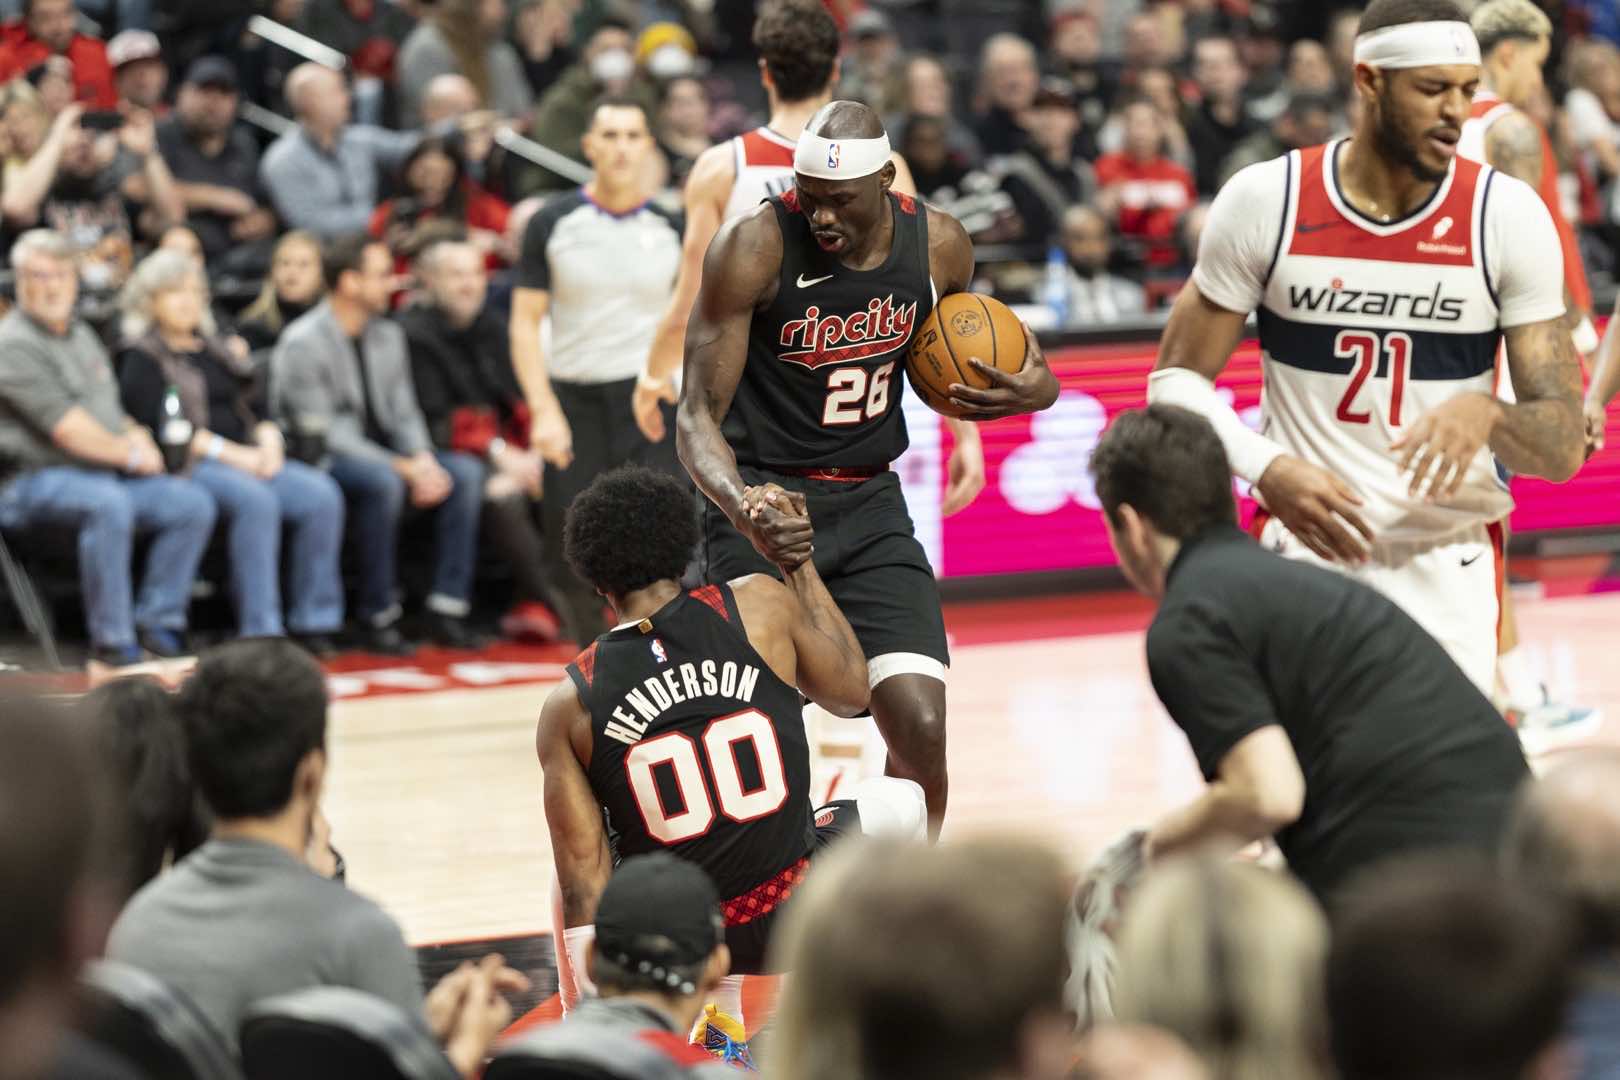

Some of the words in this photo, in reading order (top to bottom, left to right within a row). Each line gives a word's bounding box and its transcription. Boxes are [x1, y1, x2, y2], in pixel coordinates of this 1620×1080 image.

[777, 294, 917, 368] ripcity
[1289, 278, 1466, 321] wizards
[822, 362, 895, 425] 26
[1334, 330, 1413, 428] 21
[604, 660, 760, 745] HENDERSON
[624, 707, 789, 844] 00
